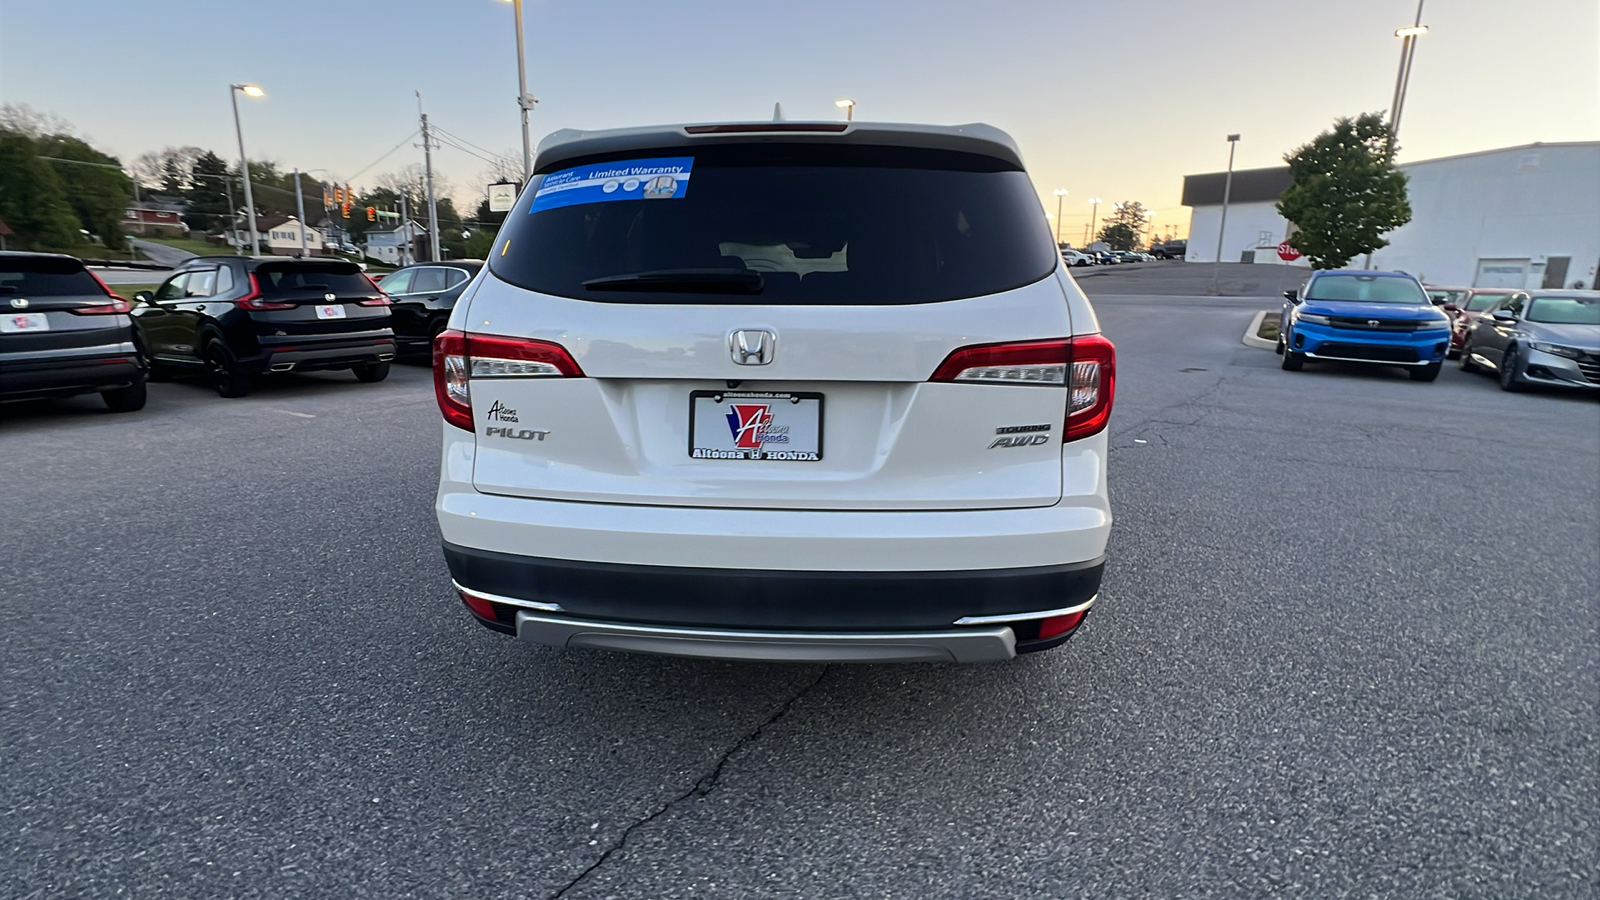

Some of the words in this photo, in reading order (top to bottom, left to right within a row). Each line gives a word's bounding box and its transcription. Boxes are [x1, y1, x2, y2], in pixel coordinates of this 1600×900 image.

[546, 171, 574, 182] Assurant
[588, 167, 630, 179] Limited
[631, 165, 684, 175] Warranty
[723, 391, 791, 399] altoonahonda.com
[486, 427, 551, 441] PILOT
[999, 423, 1052, 434] TOURING
[756, 433, 789, 443] Honda
[987, 434, 1050, 449] AWD
[692, 448, 745, 459] Altoona
[766, 450, 819, 460] HONDA
